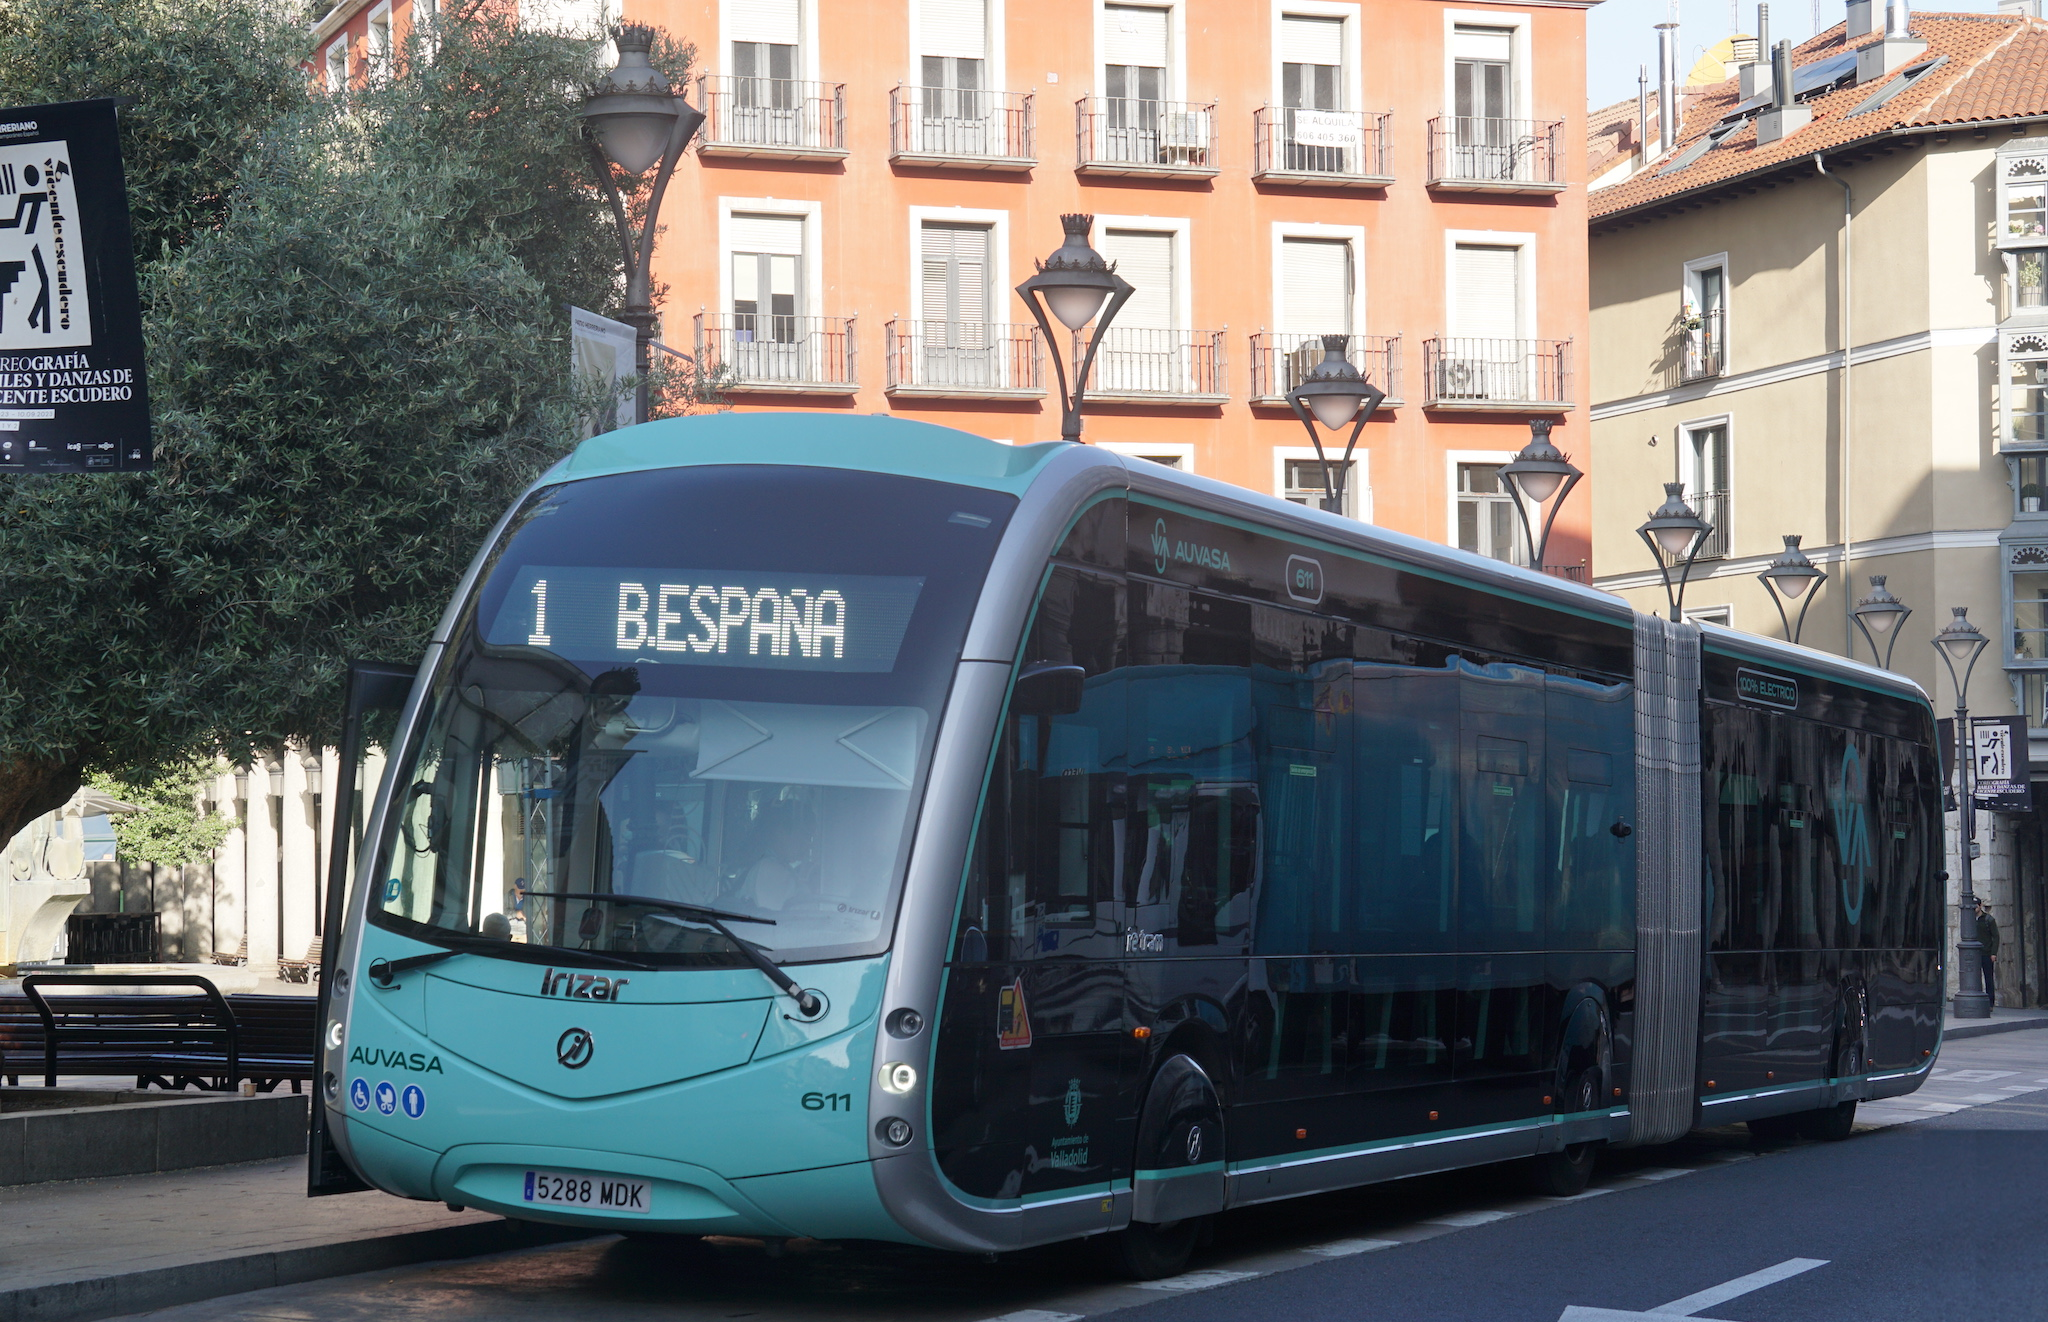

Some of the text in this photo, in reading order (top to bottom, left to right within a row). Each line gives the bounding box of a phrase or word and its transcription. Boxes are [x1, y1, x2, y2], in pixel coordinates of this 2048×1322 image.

[0, 121, 38, 133] RERIANO
[1296, 116, 1355, 127] SE ALQUILA
[1297, 131, 1356, 143] 606 405 360
[0, 351, 90, 371] REOGRAFÍA
[35, 372, 47, 387] Y
[49, 369, 111, 387] DANZAS
[113, 368, 134, 384] DE
[51, 385, 132, 404] ESCUDERO
[1175, 540, 1231, 571] AUVASA
[1296, 568, 1314, 590] 611
[528, 579, 846, 659] 1 B.ESPAÑA
[1740, 677, 1759, 693] 100%
[350, 1046, 444, 1075] AUVASA
[801, 1091, 851, 1112] 611
[1050, 1147, 1089, 1168] Valladolid
[538, 1176, 593, 1203] 5288
[600, 1181, 644, 1208] MDK
